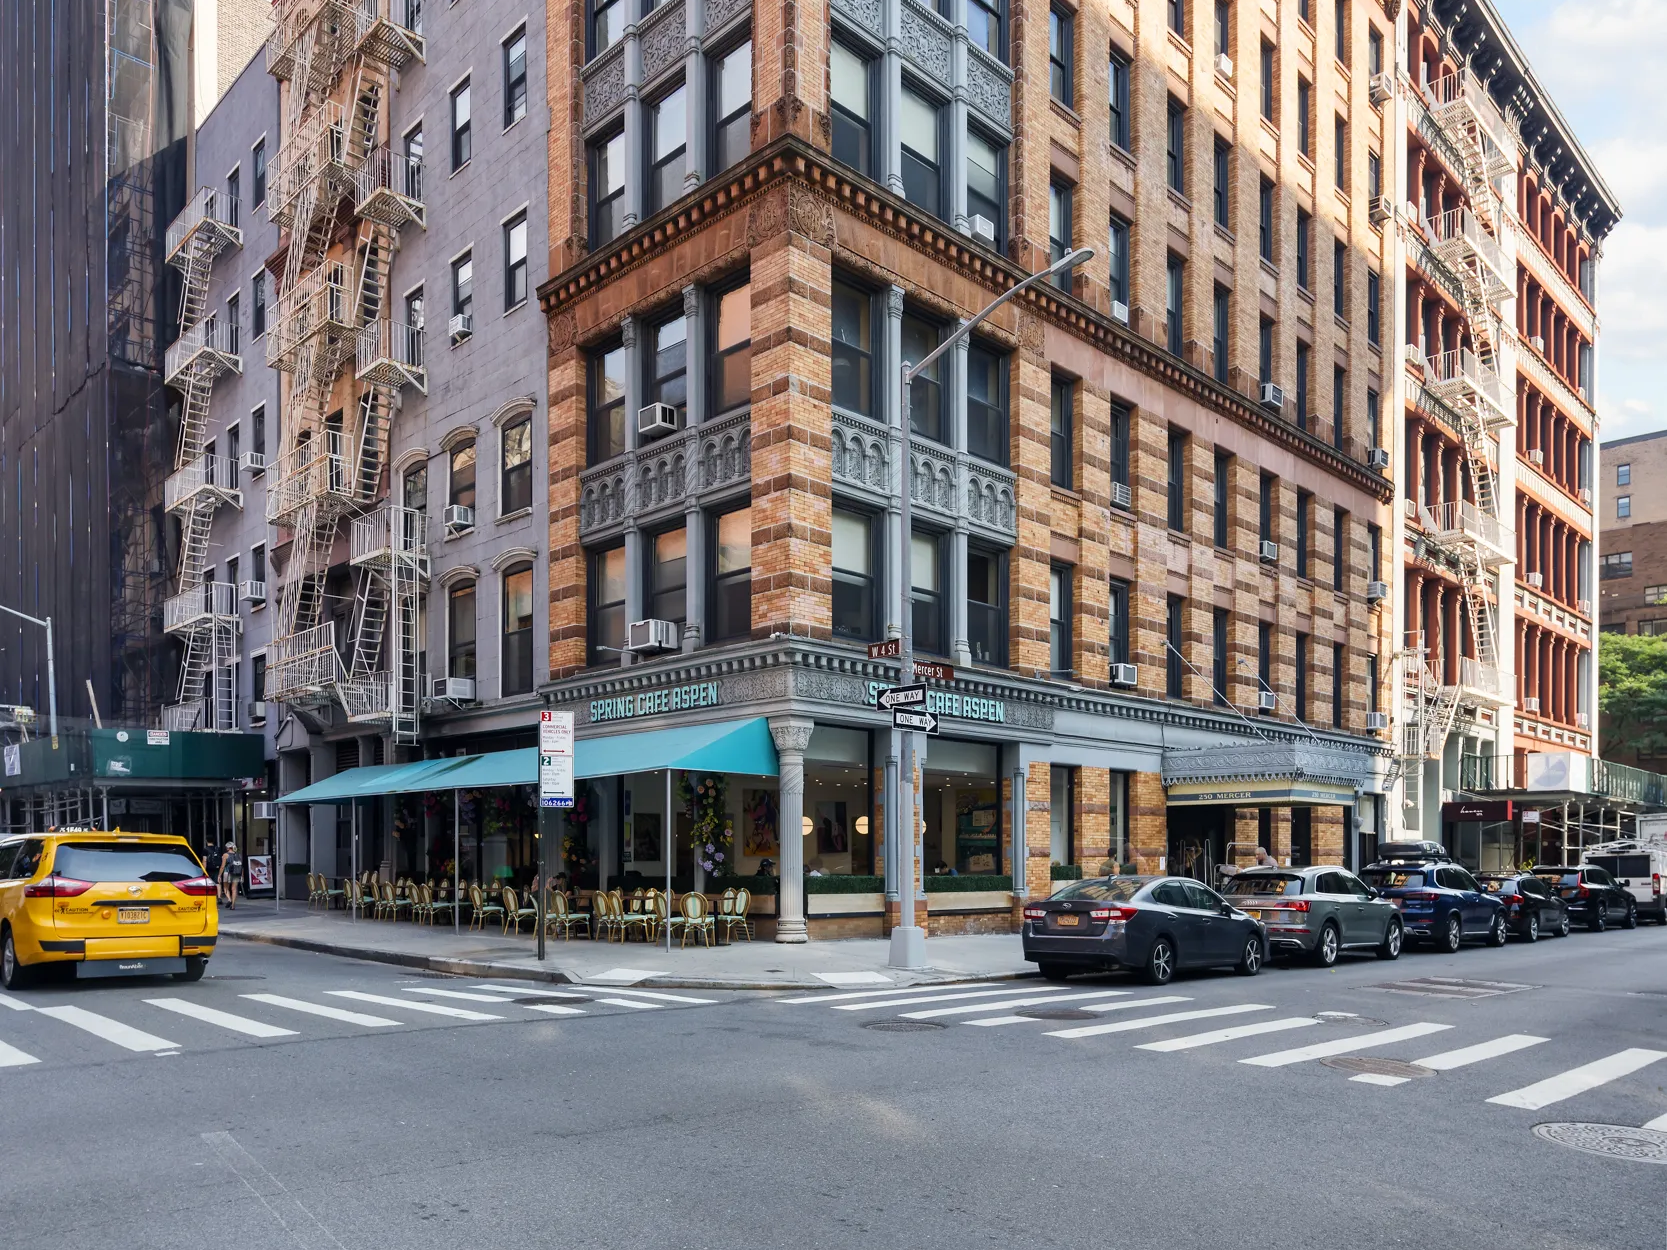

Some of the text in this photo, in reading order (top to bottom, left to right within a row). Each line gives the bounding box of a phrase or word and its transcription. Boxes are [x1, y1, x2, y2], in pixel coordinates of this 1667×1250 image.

[871, 643, 896, 657] W 4 St
[912, 662, 943, 678] Mercer St
[590, 681, 718, 721] SPRING CAFE ASPEN
[885, 691, 920, 704] ONE WAY
[926, 691, 960, 716] CAFE
[963, 696, 1004, 722] ASPEN
[543, 712, 550, 721] 3
[900, 714, 933, 727] ONE WAY
[543, 757, 550, 765] 2
